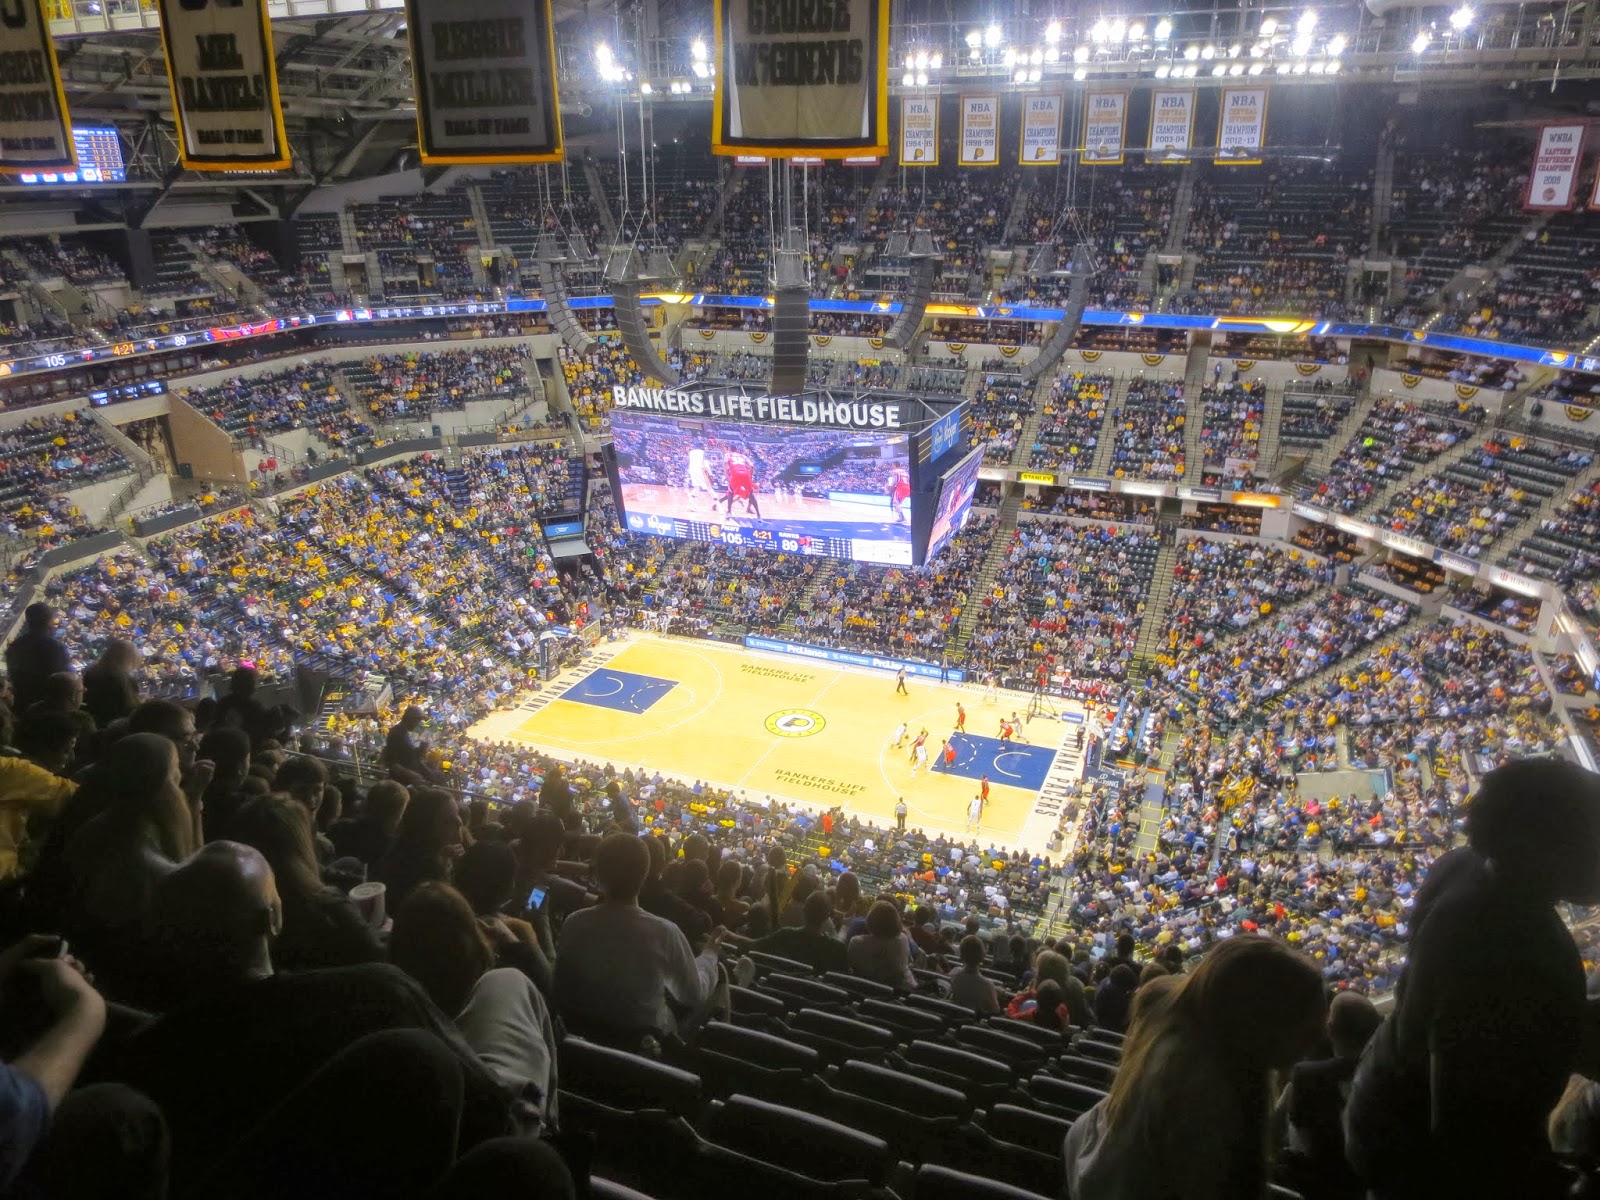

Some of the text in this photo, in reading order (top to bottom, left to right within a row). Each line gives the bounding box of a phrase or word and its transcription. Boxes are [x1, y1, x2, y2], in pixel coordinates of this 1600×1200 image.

[1032, 101, 1053, 110] NBA
[1096, 99, 1116, 108] NBA
[1162, 98, 1184, 107] NBA
[1232, 96, 1256, 106] NBA
[910, 104, 928, 113] NBA
[971, 104, 990, 112] NBA
[906, 130, 933, 138] CHAMPIONS
[966, 129, 994, 138] CHAMPIONS
[1027, 128, 1056, 136] CHAMPIONS
[1089, 126, 1119, 135] CHAMPIONS
[1156, 125, 1186, 134] CHAMPIONS
[1226, 125, 1257, 134] CHAMPIONS
[1550, 134, 1572, 142] WNBA
[174, 335, 187, 346] 89
[113, 344, 135, 356] 4:21
[45, 354, 66, 368] 105
[613, 386, 900, 428] BANKERS LIFE FIELDHOUSE
[721, 532, 743, 545] 105
[752, 530, 772, 540] 4:21
[782, 540, 798, 552] 89
[786, 644, 828, 658] ProLiance
[741, 664, 790, 676] BANKERS
[741, 668, 808, 682] FIELDHOUSE
[520, 681, 575, 712] INDIANA
[775, 768, 867, 792] BANKERS LIFE
[776, 776, 858, 796] FIELDHOUSE
